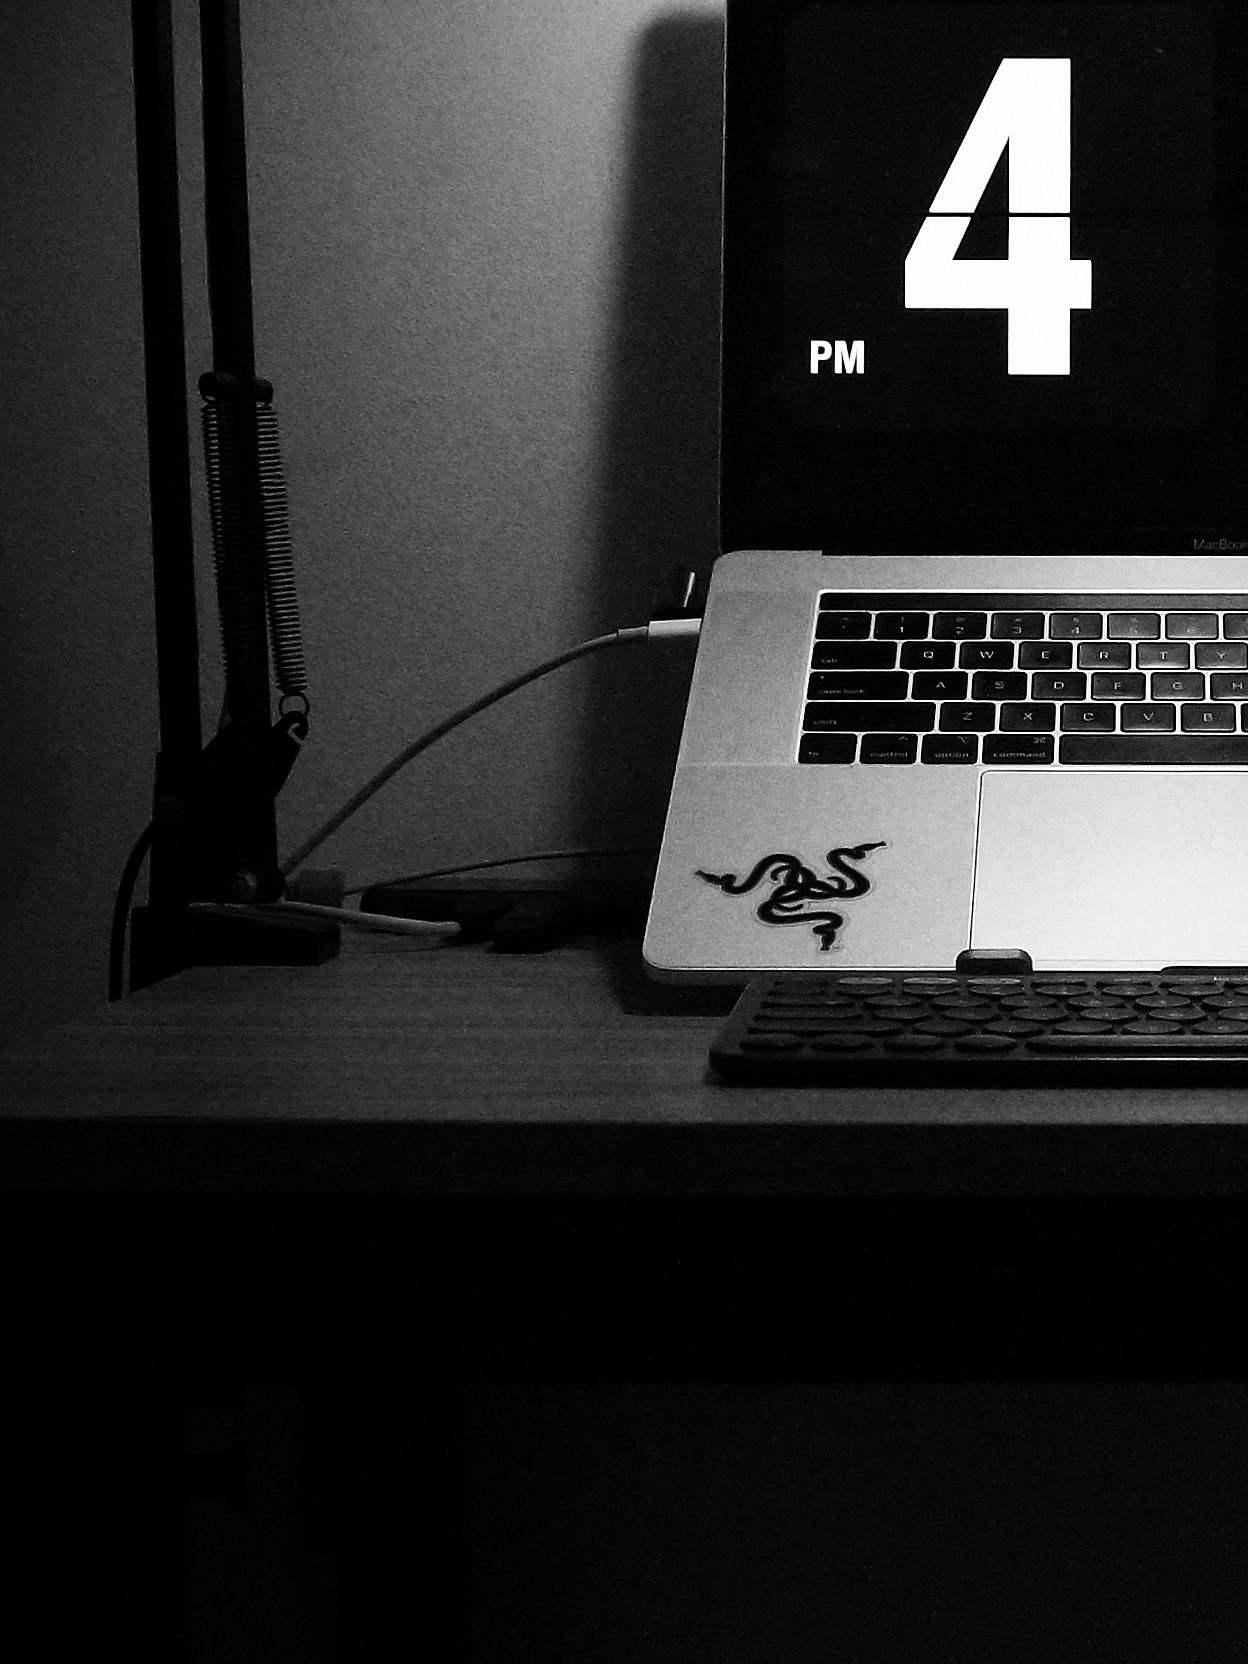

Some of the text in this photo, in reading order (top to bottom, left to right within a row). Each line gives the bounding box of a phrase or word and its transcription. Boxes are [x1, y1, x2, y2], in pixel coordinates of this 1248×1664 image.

[905, 58, 1092, 375] 4
[811, 340, 864, 374] PM
[923, 649, 934, 660] Q
[979, 649, 994, 659] W
[1041, 650, 1050, 660] E
[1097, 650, 1108, 660] R
[1158, 650, 1168, 660] T
[1216, 650, 1226, 660] Y
[936, 680, 946, 689] A
[994, 680, 1005, 690] S
[1053, 681, 1064, 690] D
[1114, 681, 1122, 690] F
[1172, 681, 1182, 690] G
[1232, 682, 1243, 690] H
[963, 711, 973, 721] Z
[1023, 712, 1033, 721] X
[1083, 712, 1094, 721] C
[1143, 712, 1154, 721] V
[1203, 712, 1213, 722] B
[993, 751, 1046, 759] command
